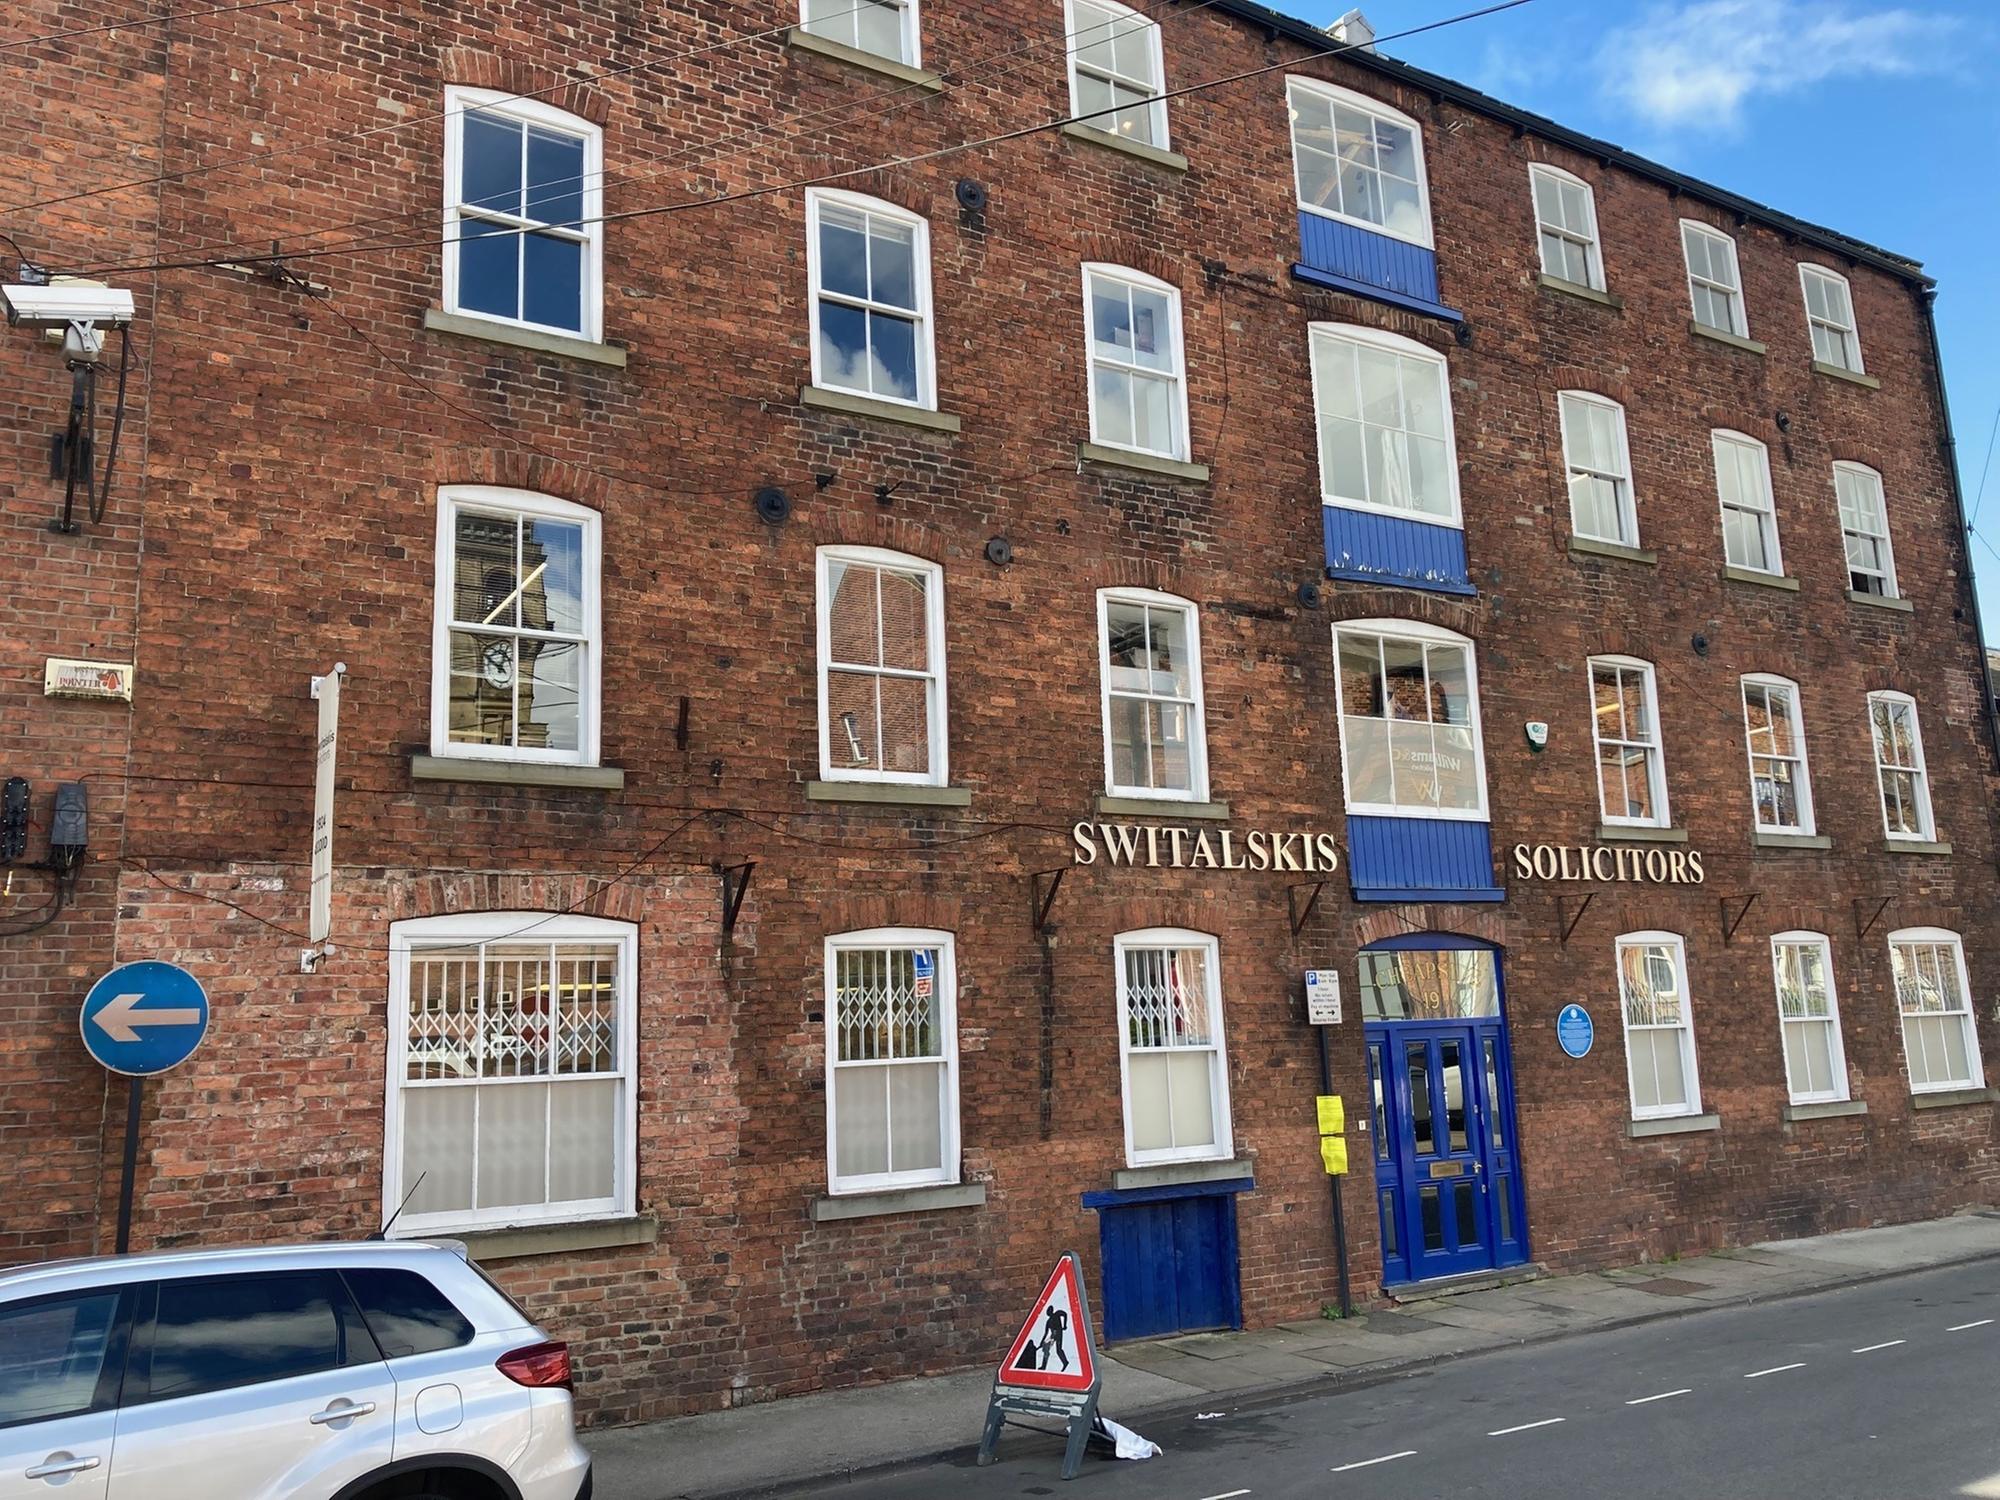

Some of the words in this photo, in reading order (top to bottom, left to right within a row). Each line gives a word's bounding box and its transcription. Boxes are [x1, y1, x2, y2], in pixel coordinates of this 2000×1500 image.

[1073, 821, 1338, 873] SWITALSKIS
[1514, 843, 1705, 884] SOLICITORS
[1375, 962, 1481, 990] CHEAPSI
[1423, 991, 1440, 1009] 19
